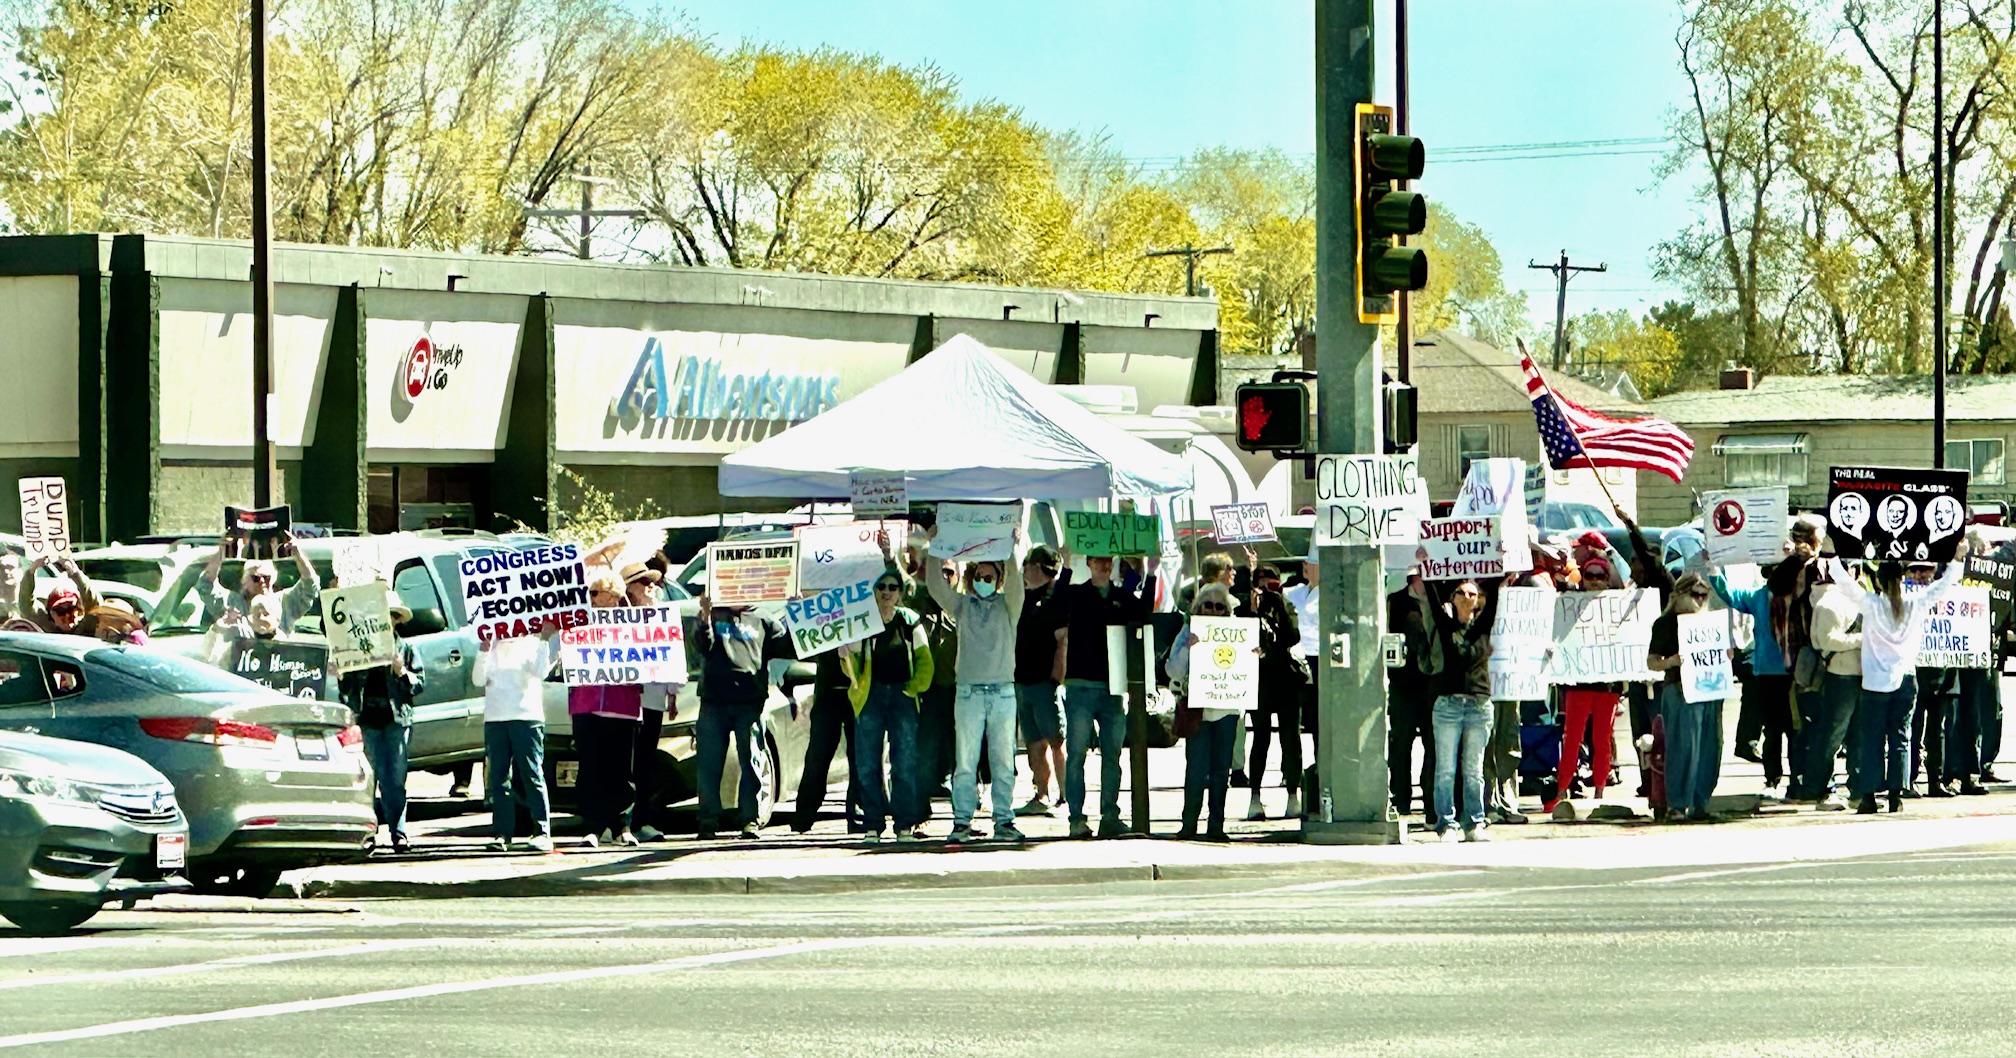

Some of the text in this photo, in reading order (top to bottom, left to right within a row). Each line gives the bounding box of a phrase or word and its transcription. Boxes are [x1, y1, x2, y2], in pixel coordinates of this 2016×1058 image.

[1317, 457, 1416, 500] CLOTHING
[1066, 513, 1158, 532] EDUCATION
[1330, 504, 1404, 539] DRIVE
[1420, 518, 1493, 541] Support
[716, 548, 763, 561] HANDS
[1109, 532, 1146, 555] ALL
[1457, 541, 1491, 556] our
[461, 544, 578, 576] CONGRESS
[1422, 557, 1503, 578] Veterans
[466, 576, 511, 599] ACT
[331, 596, 346, 625] 6
[482, 586, 589, 619] ECONOMY
[785, 580, 873, 624] PEOPLE
[1561, 596, 1641, 625] ROTECT
[592, 607, 670, 625] RRUPT
[795, 610, 870, 653] PROFIT
[1202, 624, 1247, 643] JESUS
[1575, 625, 1622, 645] THE
[237, 648, 260, 672] No
[577, 646, 671, 664] TYRANT
[565, 666, 639, 683] FRAUD
